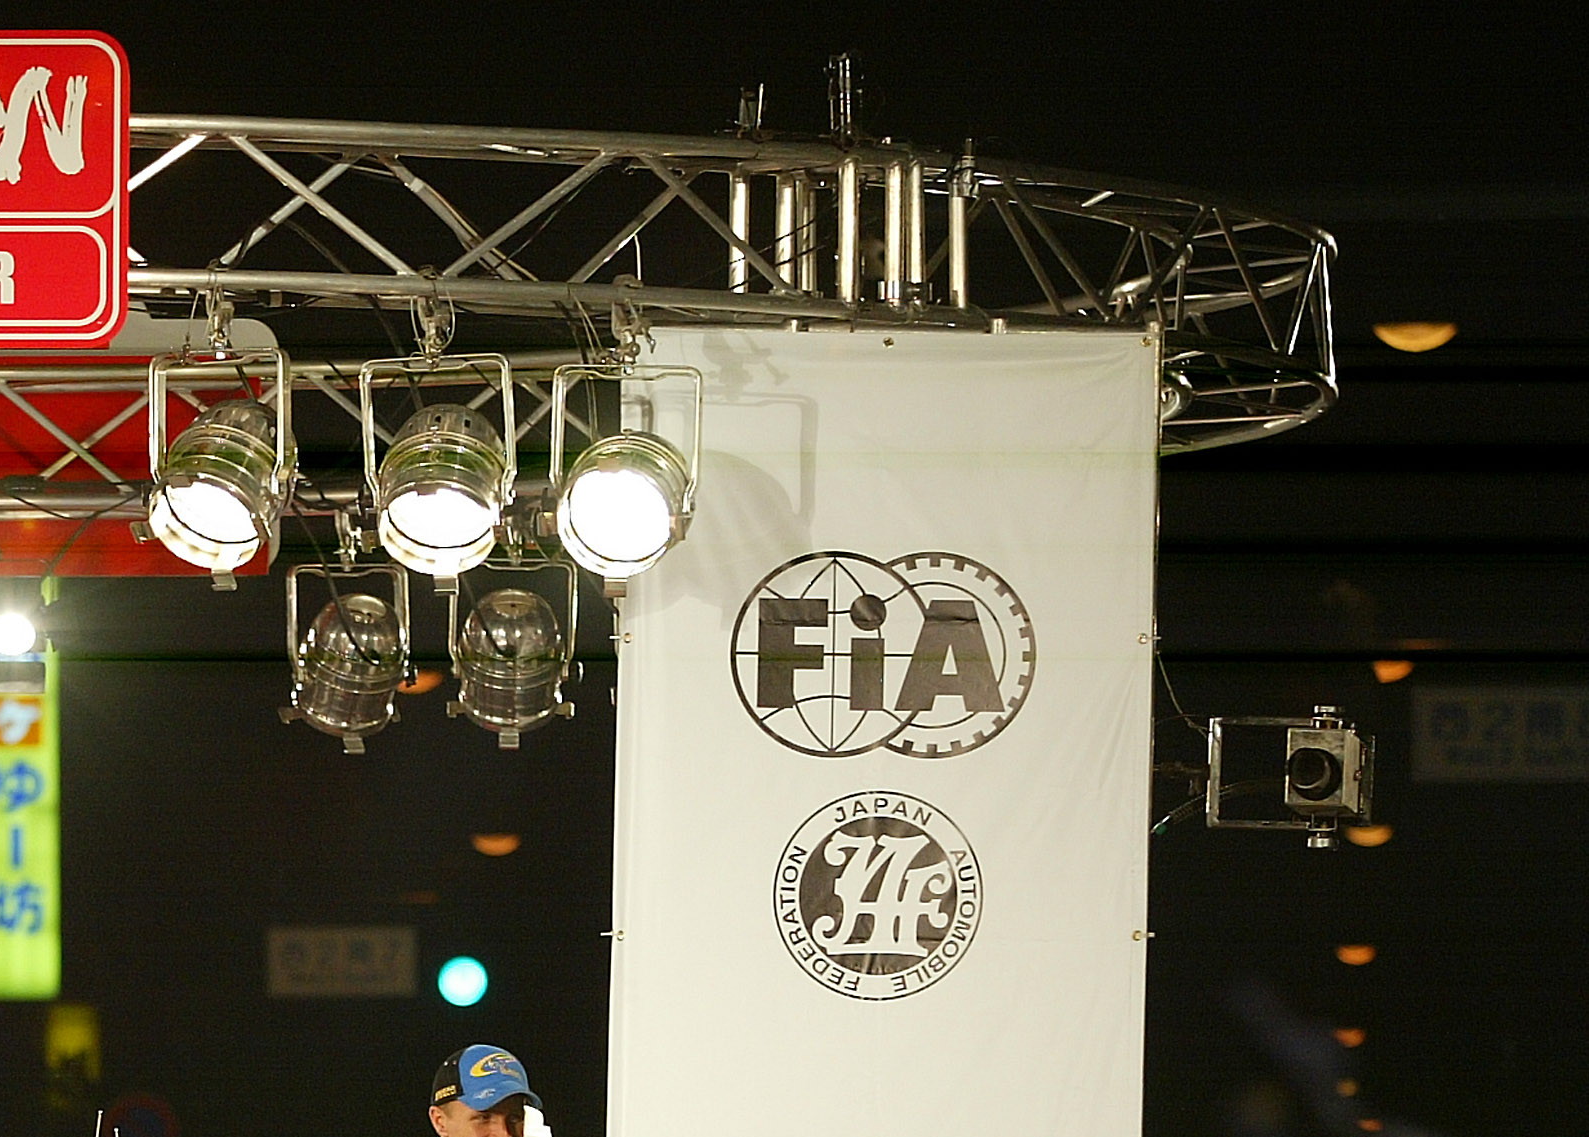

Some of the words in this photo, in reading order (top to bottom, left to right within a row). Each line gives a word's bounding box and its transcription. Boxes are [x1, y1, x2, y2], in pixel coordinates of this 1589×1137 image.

[834, 797, 934, 827] JAPAN
[778, 845, 861, 993] FEDERATION
[889, 847, 978, 995] AUTOMOBILE
